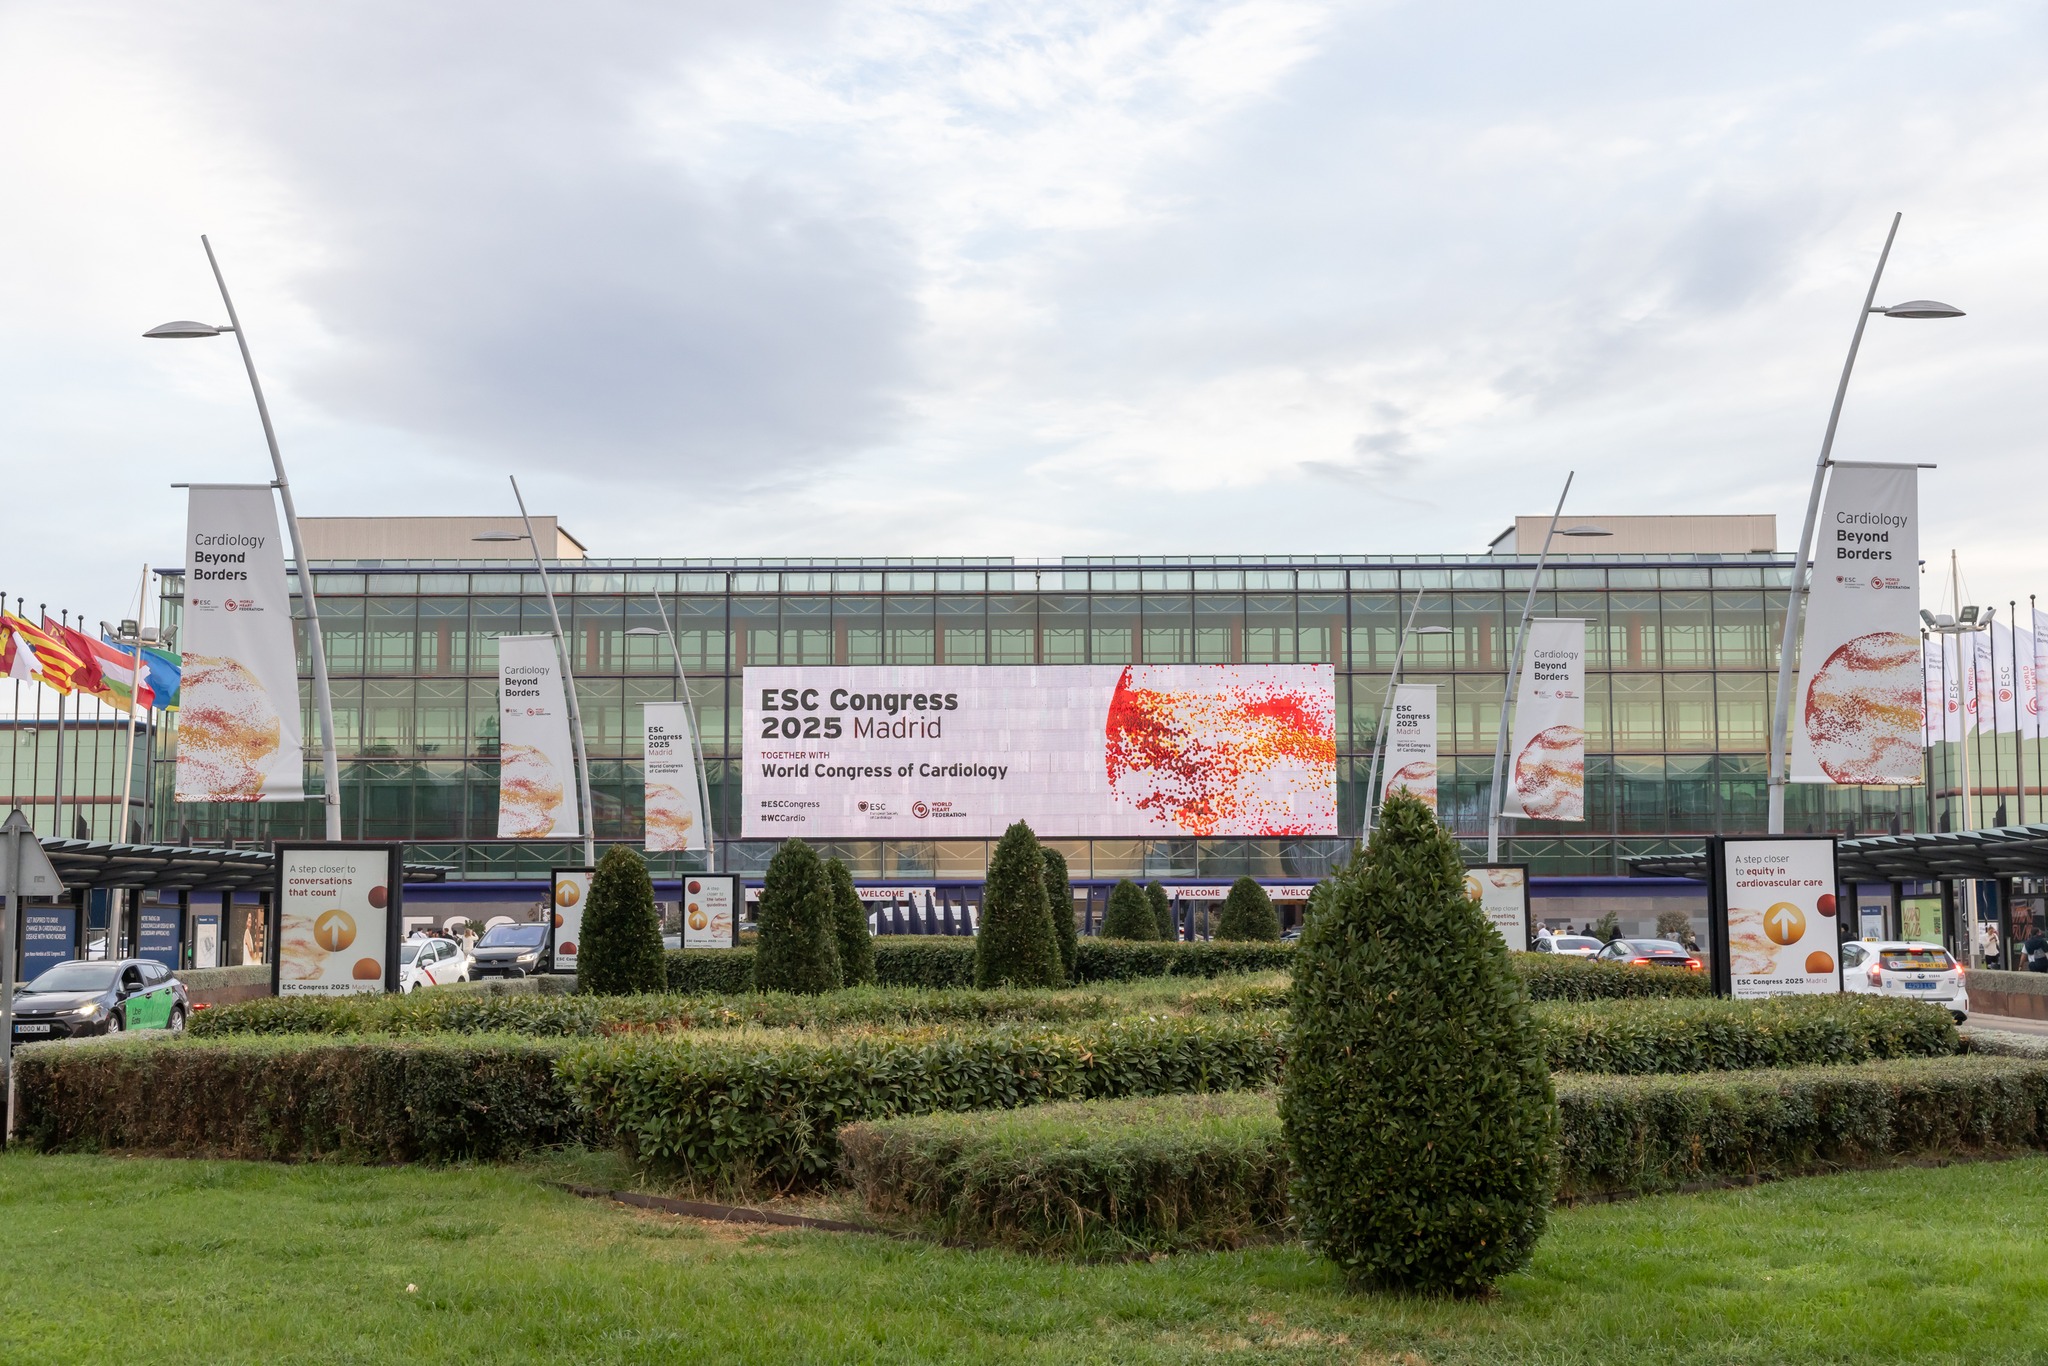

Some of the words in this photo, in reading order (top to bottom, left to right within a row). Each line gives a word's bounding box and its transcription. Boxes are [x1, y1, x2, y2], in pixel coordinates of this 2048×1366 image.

[1836, 512, 1908, 528] Cardiology
[195, 534, 265, 549] Cardiology
[1837, 530, 1888, 544] Beyond
[195, 551, 245, 565] Beyond
[1837, 547, 1892, 560] Borders
[194, 569, 247, 580] Borders
[1534, 650, 1579, 660] Cardiology
[505, 666, 550, 675] Cardiology
[1534, 662, 1567, 670] Beyond
[505, 678, 538, 686] Beyond
[2001, 666, 2010, 687] ESC
[1950, 680, 1958, 698] ESC
[761, 688, 819, 711] ESC
[830, 688, 958, 716] Congress
[761, 717, 842, 739] 2025
[854, 716, 941, 738] Madrid
[762, 763, 809, 777] World
[815, 763, 892, 780] Congress
[897, 763, 914, 777] of
[919, 763, 1008, 779] Cardiology
[761, 800, 820, 809] #ESCCongress
[1735, 856, 1742, 864] A
[1744, 855, 1762, 864] step
[1764, 855, 1789, 863] closer
[299, 866, 316, 874] step
[319, 865, 344, 873] closer
[1747, 867, 1774, 877] equity
[289, 877, 352, 885] conversations
[1736, 879, 1800, 888] cardiovascular
